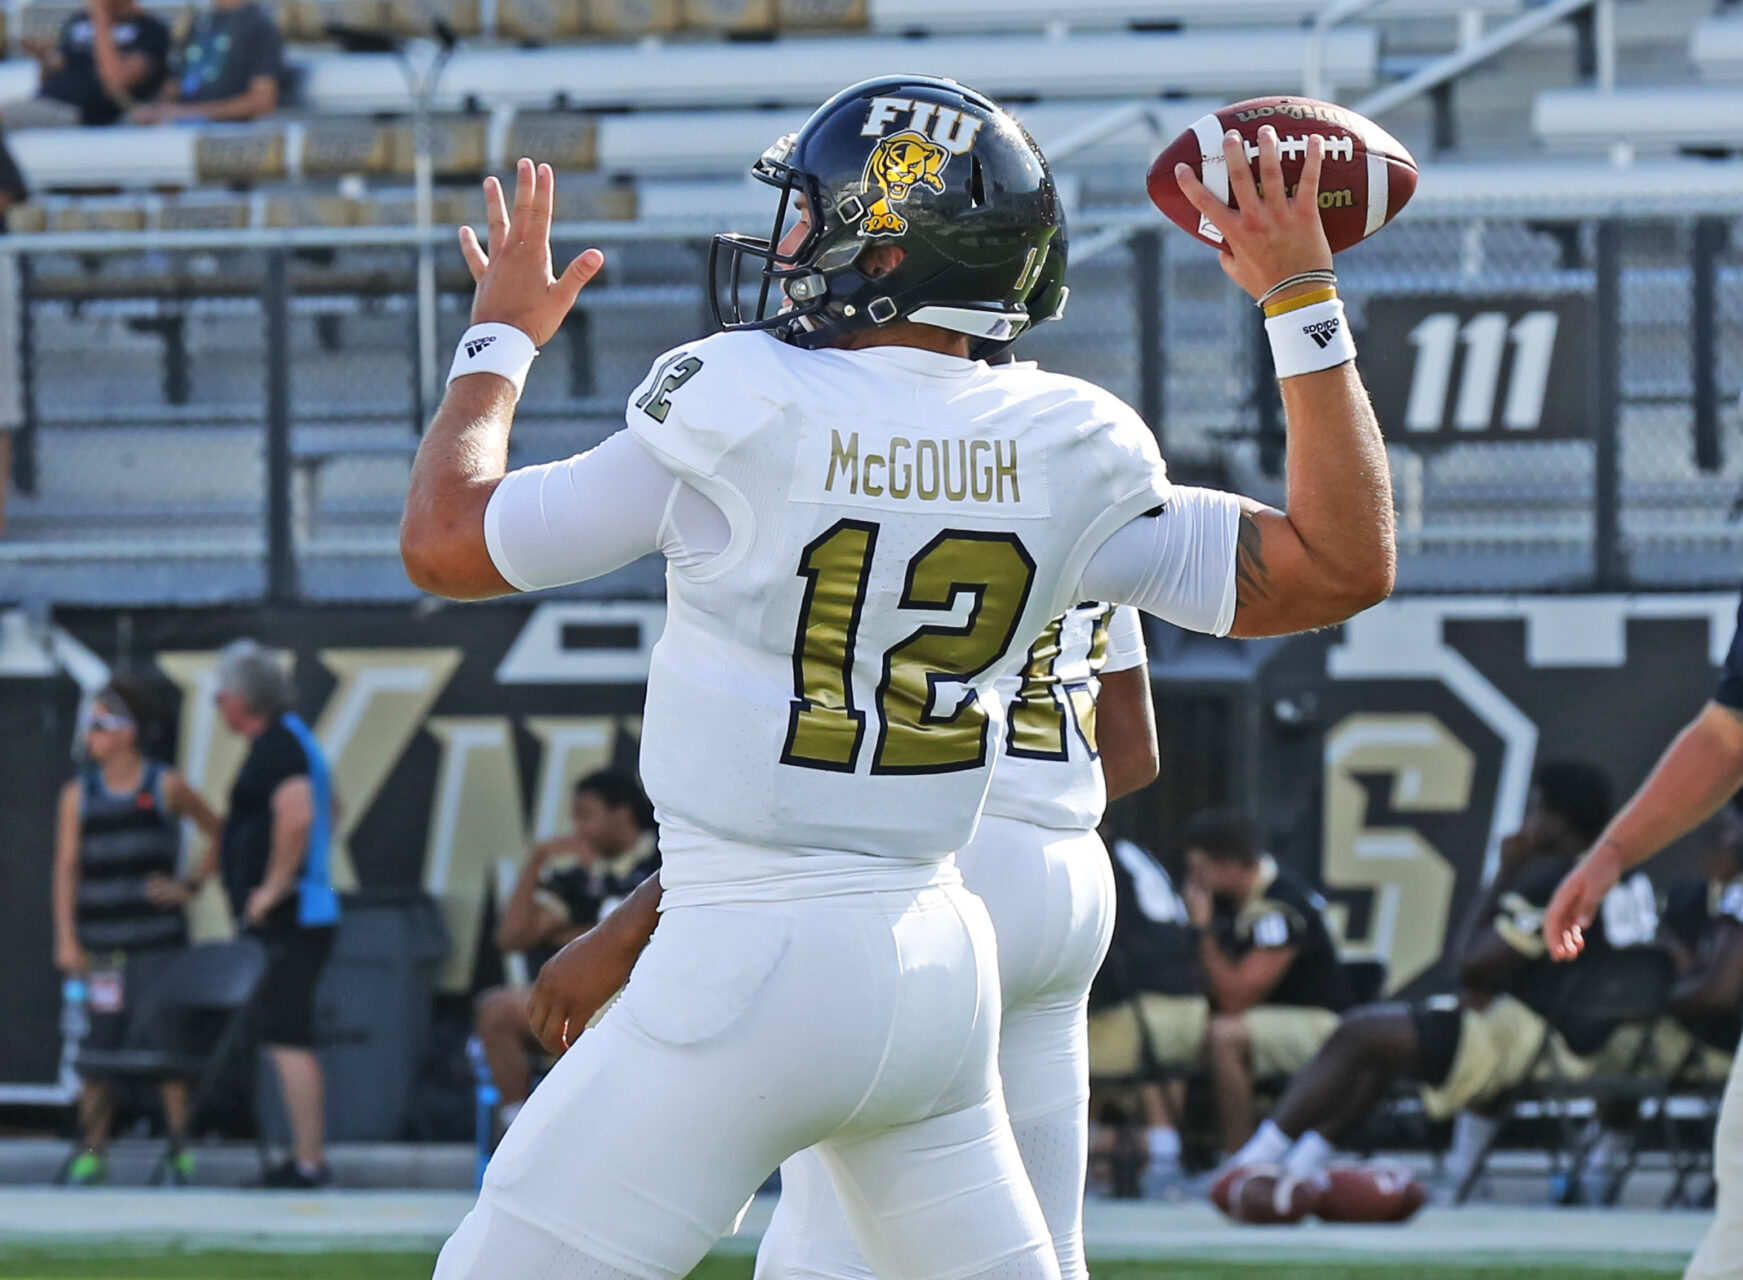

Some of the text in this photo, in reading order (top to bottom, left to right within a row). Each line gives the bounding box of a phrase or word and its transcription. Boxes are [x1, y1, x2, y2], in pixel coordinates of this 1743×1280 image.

[860, 97, 984, 156] FIU
[1302, 318, 1340, 335] adidas
[635, 351, 704, 424] 12
[1403, 310, 1560, 432] 111
[825, 429, 1020, 502] McGOUGH
[779, 517, 1037, 776] 12
